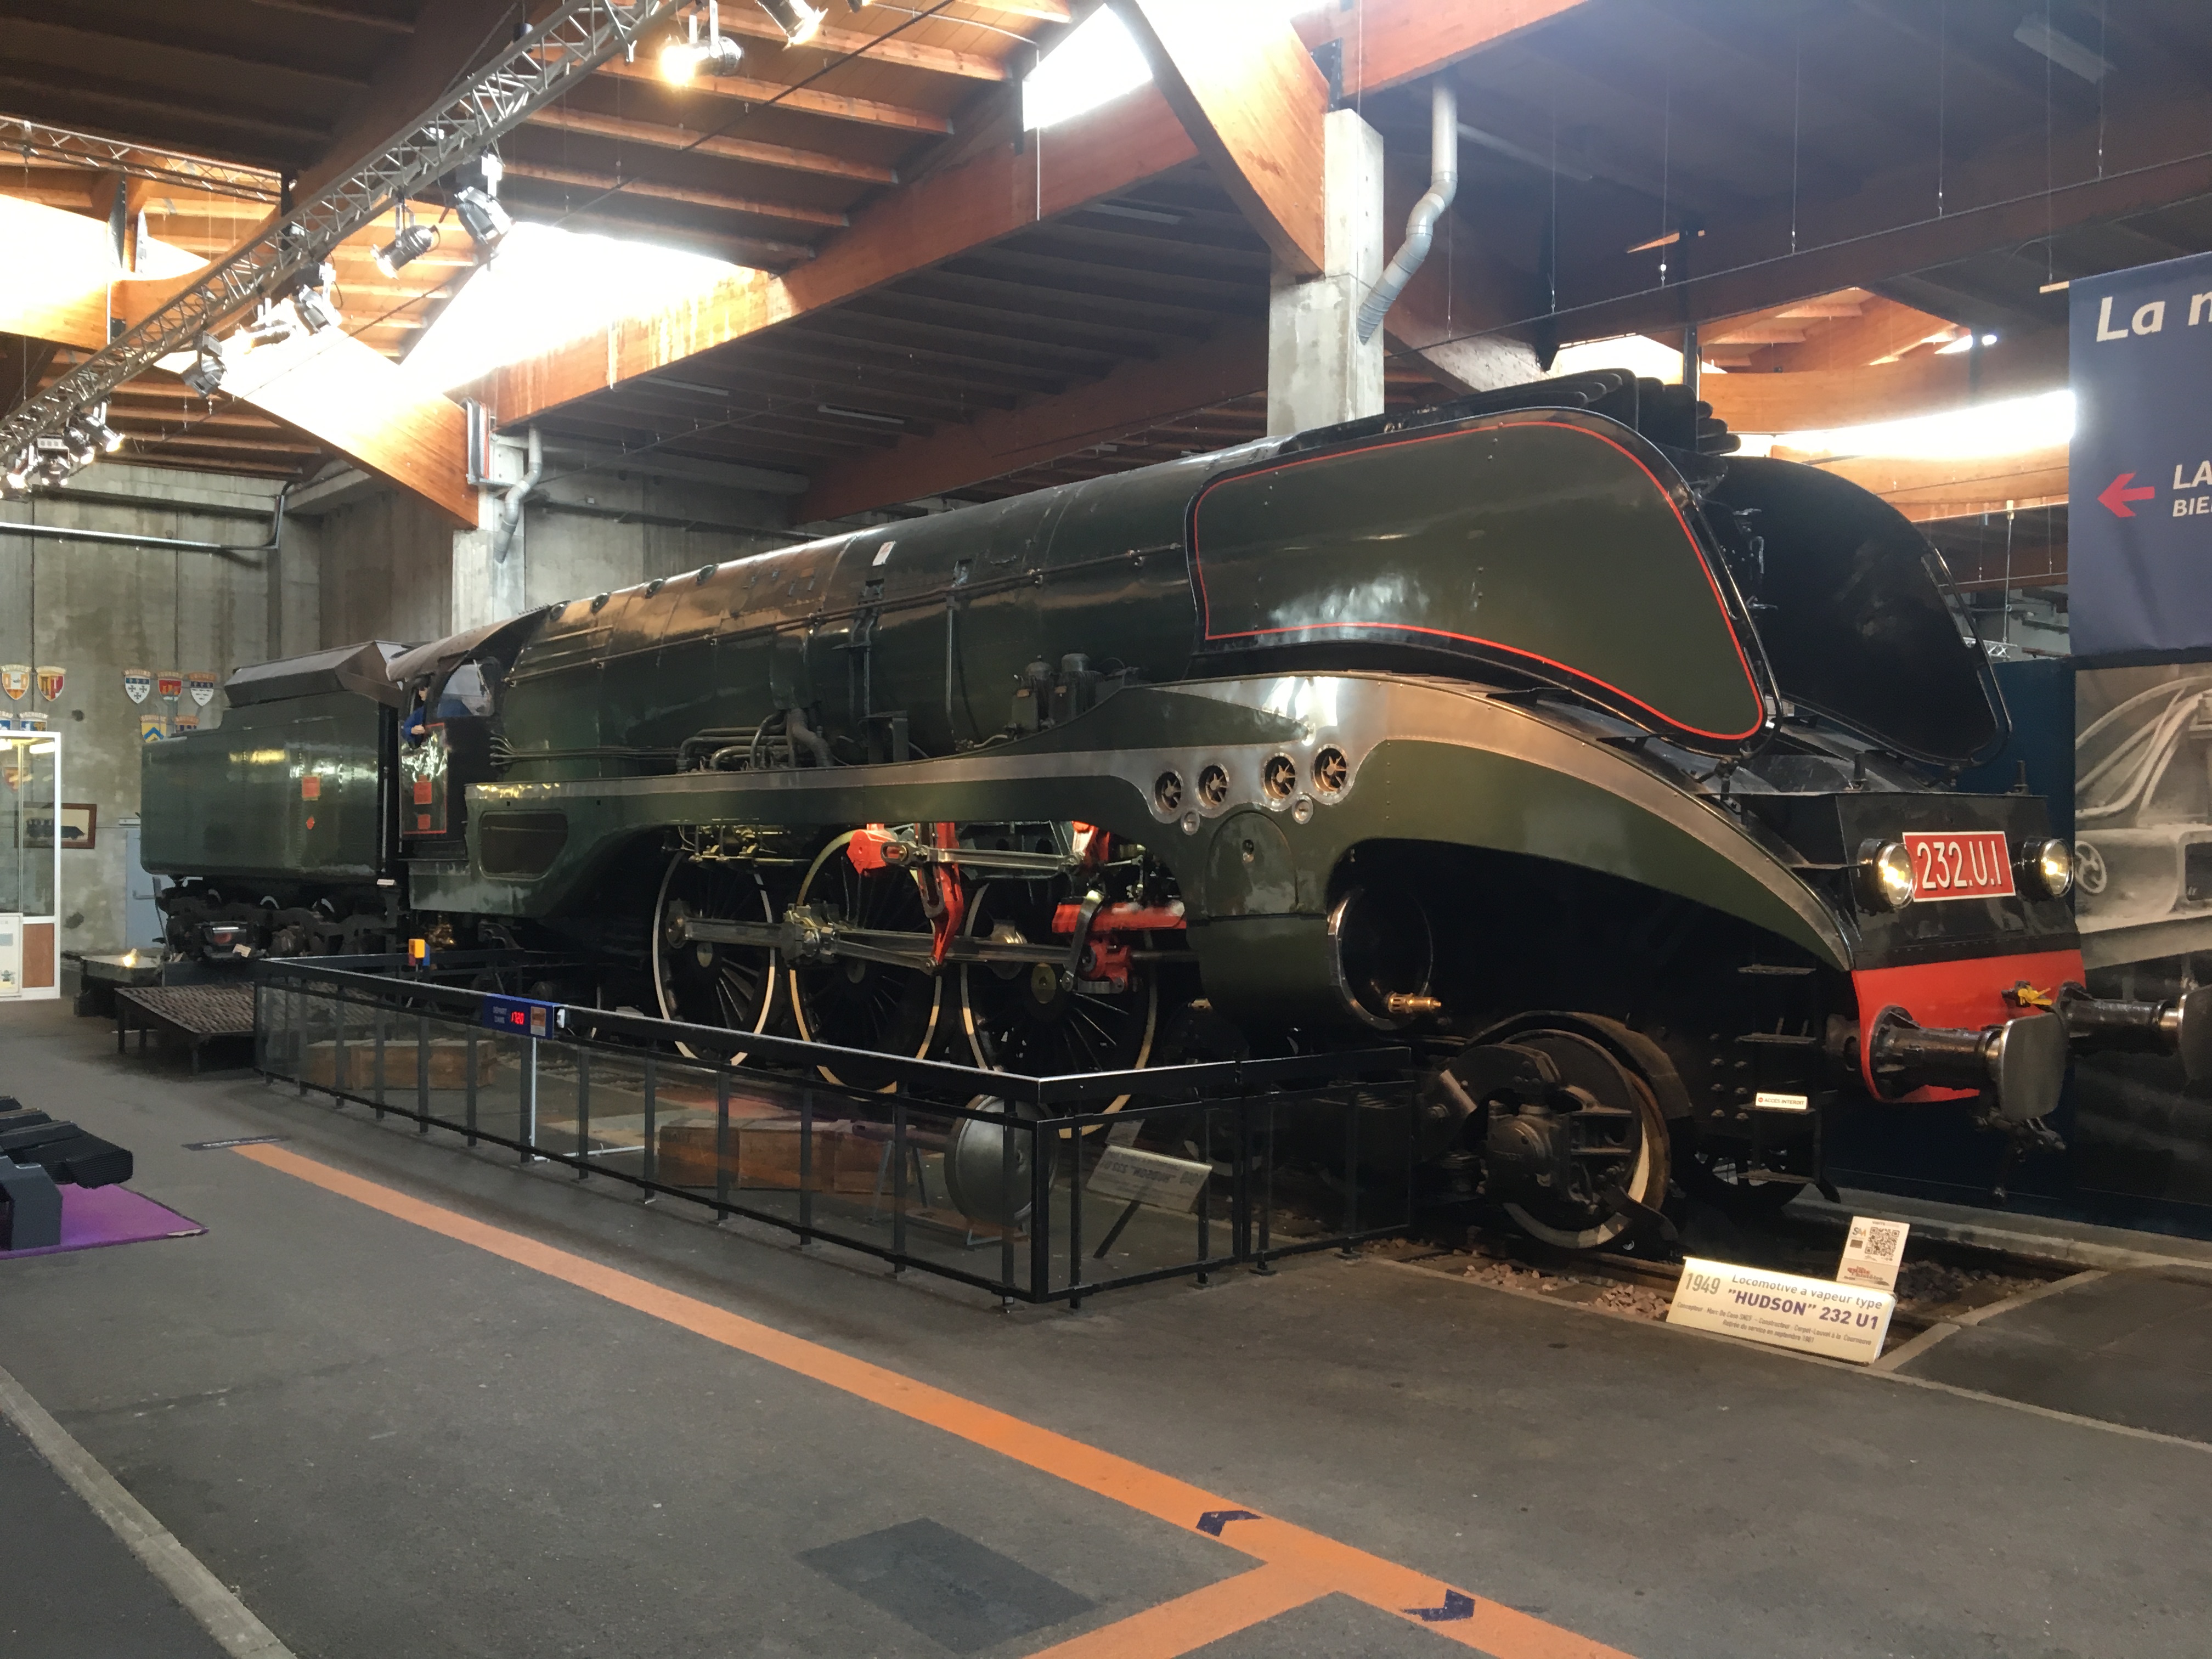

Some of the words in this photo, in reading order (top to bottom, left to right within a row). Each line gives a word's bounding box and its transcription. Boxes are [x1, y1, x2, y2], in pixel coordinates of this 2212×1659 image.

[2096, 296, 2165, 342] La
[2172, 495, 2212, 517] BIE
[1685, 1273, 1721, 1295] 1949
[1732, 1274, 1798, 1294] Locomotive
[1811, 1290, 1853, 1304] vapeur
[1856, 1296, 1882, 1310] type
[1819, 1307, 1852, 1325] 232
[1856, 1313, 1878, 1330] U1
